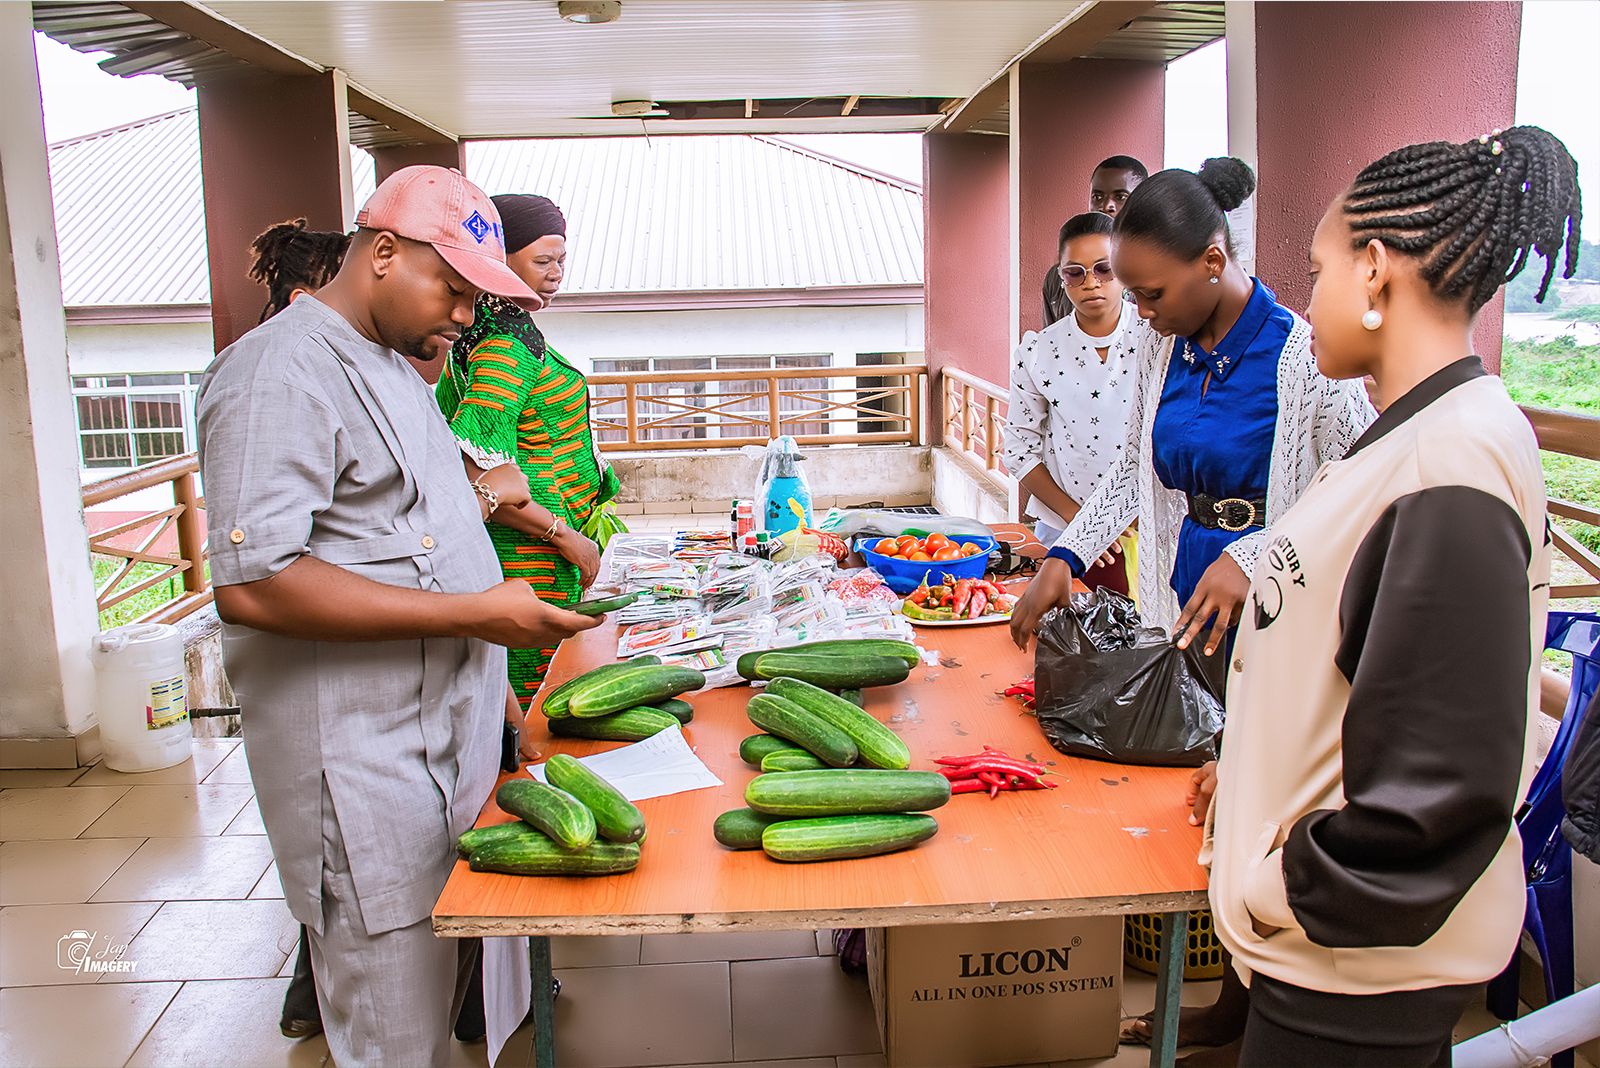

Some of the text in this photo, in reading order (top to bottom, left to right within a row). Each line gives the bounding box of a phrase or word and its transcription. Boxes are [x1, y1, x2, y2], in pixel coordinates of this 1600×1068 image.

[959, 947, 1072, 977] LICON
[911, 975, 1114, 1001] ALL IN ONE POS SYSTEM
